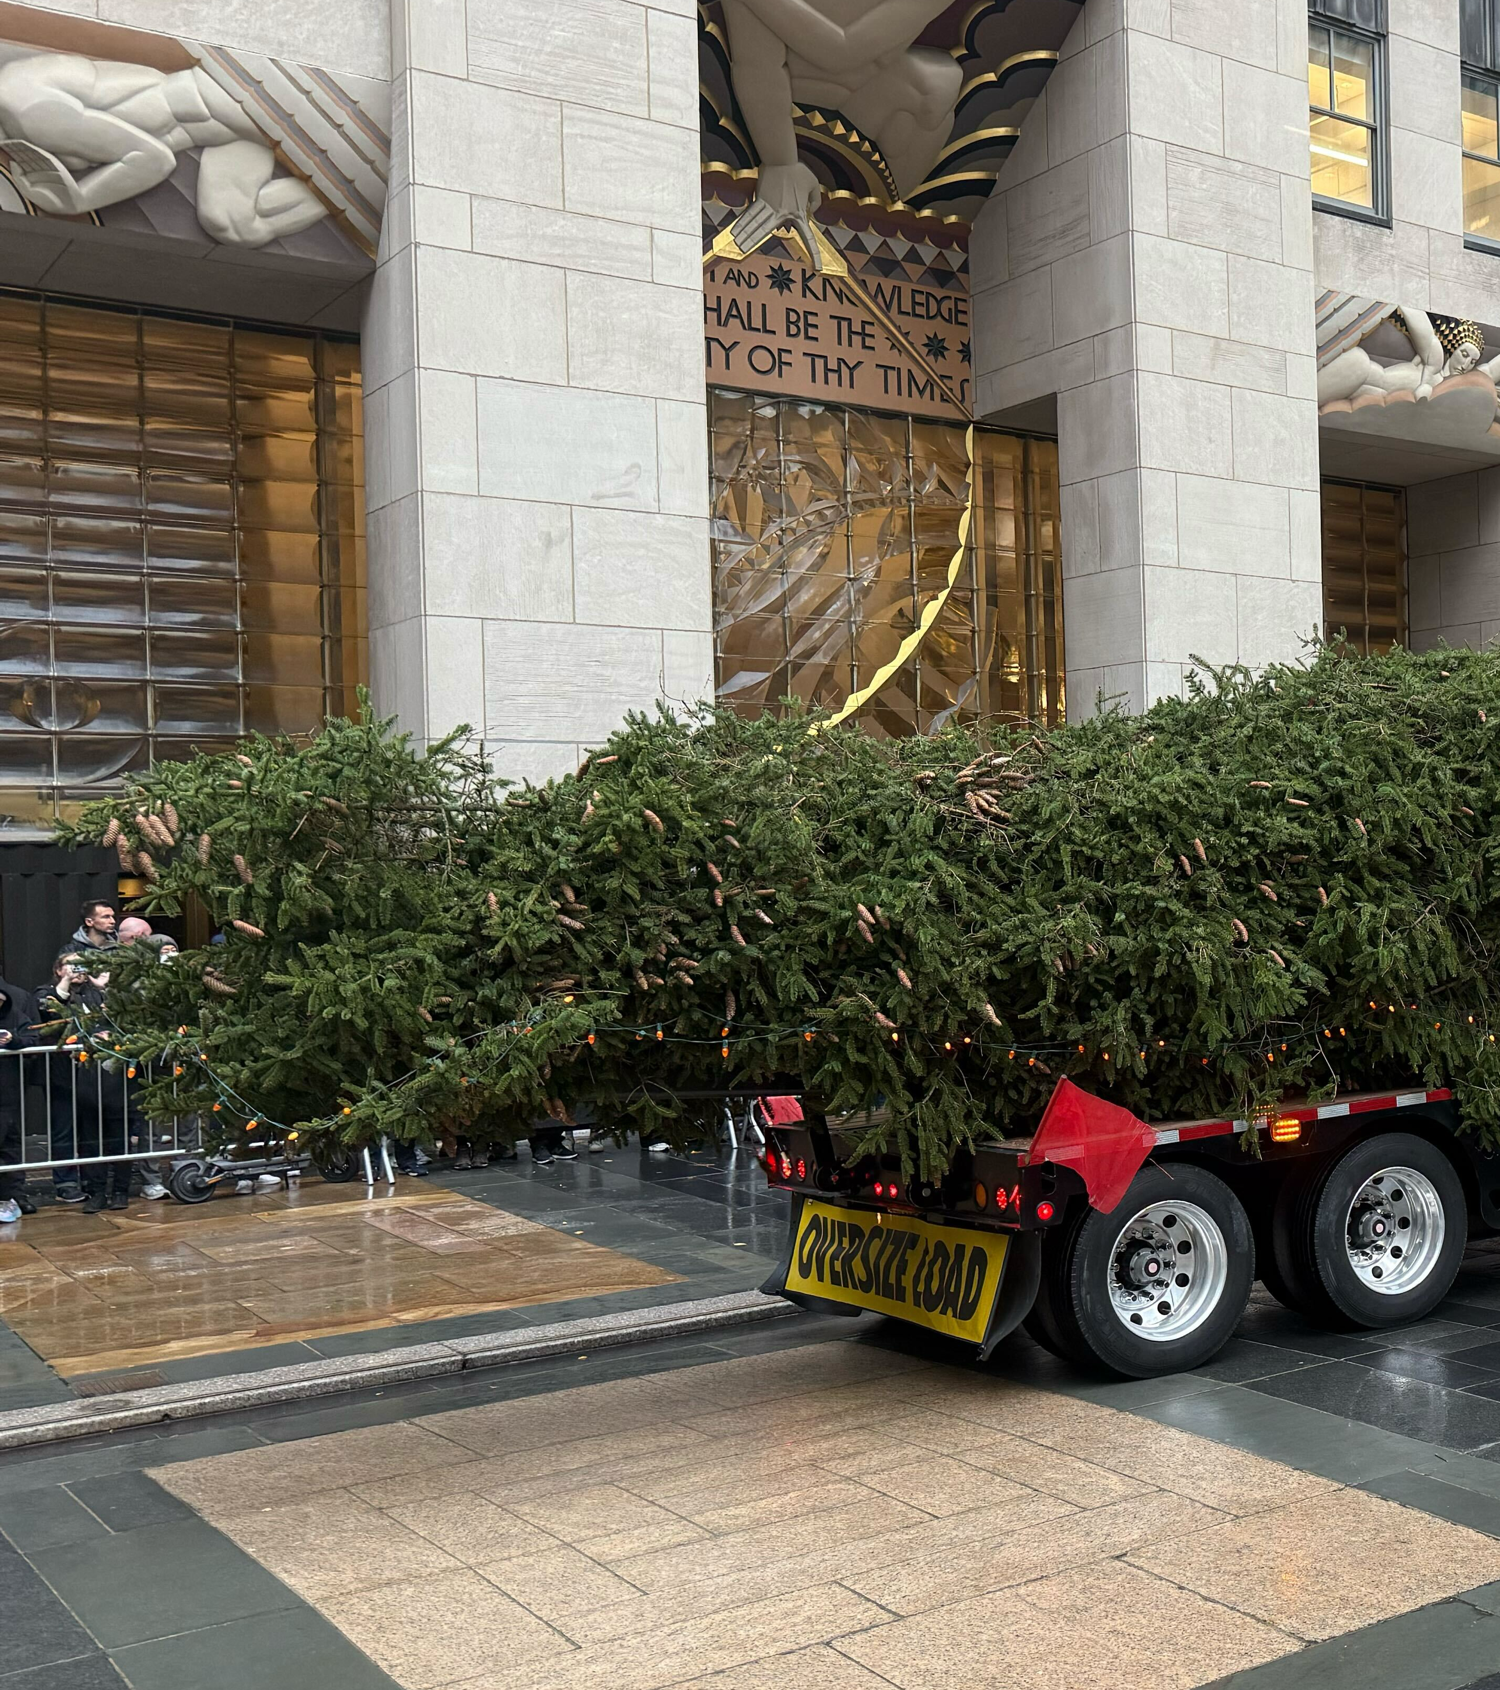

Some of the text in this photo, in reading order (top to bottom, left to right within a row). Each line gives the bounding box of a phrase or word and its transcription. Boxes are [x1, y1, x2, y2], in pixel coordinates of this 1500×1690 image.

[722, 267, 760, 289] AND
[785, 306, 819, 342] BE
[829, 314, 875, 351] THE
[747, 344, 793, 379] OF
[802, 352, 864, 390] THY
[797, 1213, 988, 1322] OVERSIZE LOAD
